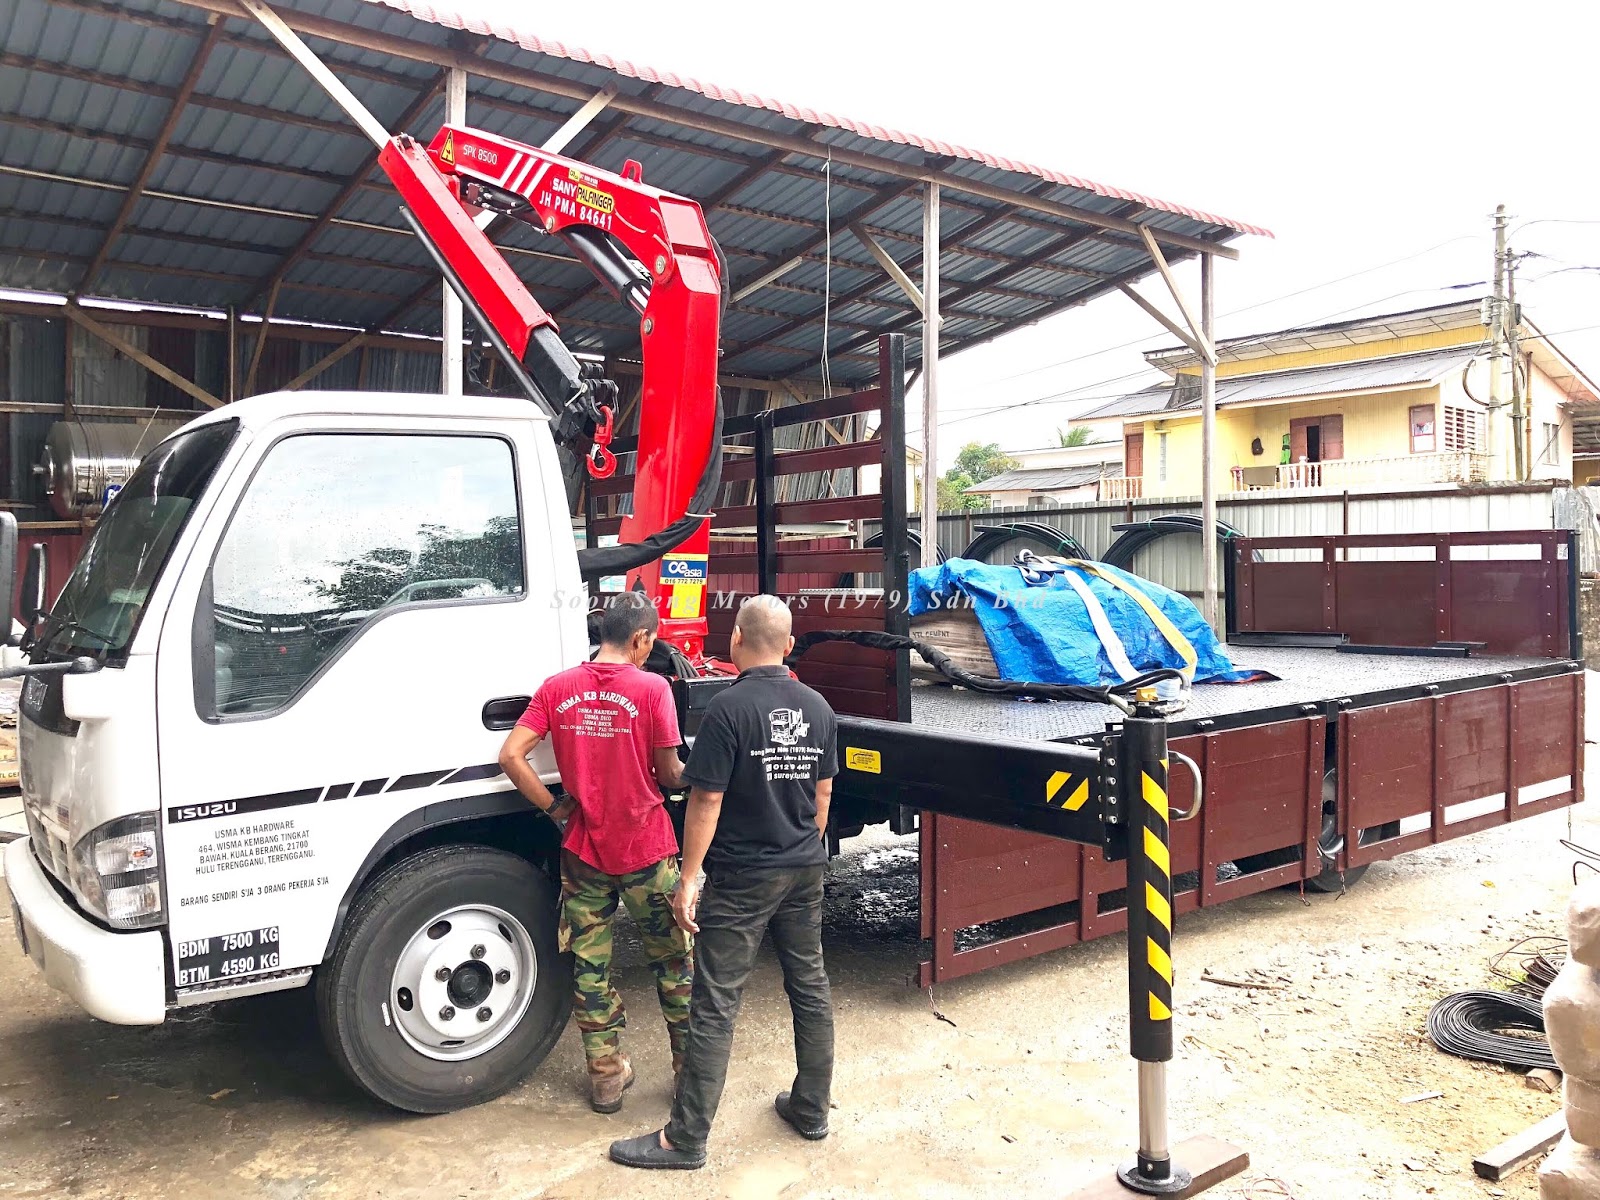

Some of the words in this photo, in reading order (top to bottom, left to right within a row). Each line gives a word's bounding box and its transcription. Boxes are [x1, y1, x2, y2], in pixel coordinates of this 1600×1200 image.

[463, 144, 476, 158] SPK
[477, 149, 498, 165] 8500
[552, 177, 577, 197] SANY
[577, 186, 613, 212] PALFINGER
[539, 190, 552, 207] JH
[554, 195, 576, 217] PMA
[579, 206, 613, 230] 84641
[925, 630, 950, 638] CEMENT
[556, 694, 582, 714] USMA
[583, 691, 597, 701] KB
[599, 691, 639, 718] HARDWARE
[177, 801, 237, 820] ISUZU
[214, 828, 238, 839] USMA
[240, 826, 251, 836] KB
[253, 820, 295, 834] HARDWARE
[216, 840, 242, 851] WISMA
[244, 834, 279, 846] KEMBANG
[281, 830, 310, 841] TINGKAT
[230, 848, 254, 859] KUALA
[287, 840, 309, 851] 21700
[195, 865, 216, 875] HULU
[180, 894, 209, 907] BARANG
[211, 890, 238, 902] SENDIRI
[257, 886, 262, 895] 3
[264, 883, 286, 894] ORANG
[288, 879, 315, 890] PEKERJA
[179, 939, 210, 959] BDM
[221, 931, 253, 952] 7500
[259, 927, 279, 944] KG
[179, 965, 210, 985] BTM
[221, 956, 255, 976] 4590
[260, 952, 279, 968] KG
